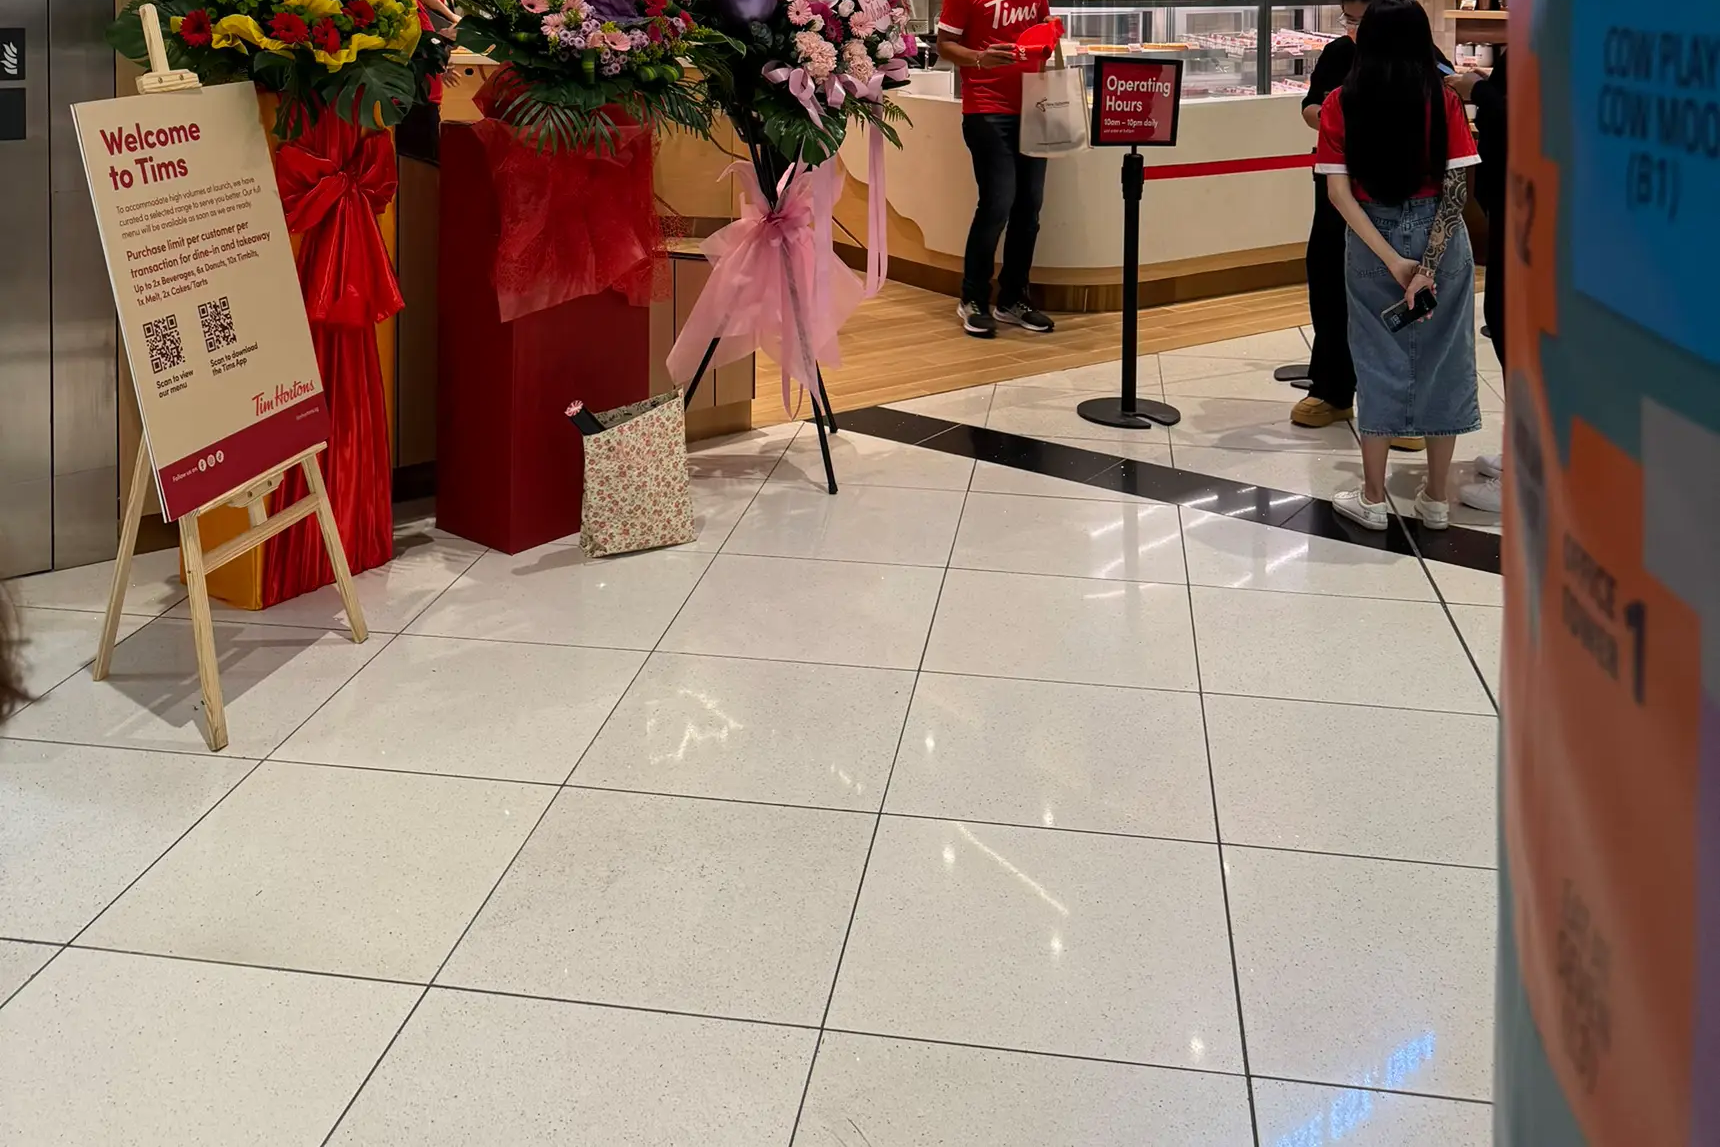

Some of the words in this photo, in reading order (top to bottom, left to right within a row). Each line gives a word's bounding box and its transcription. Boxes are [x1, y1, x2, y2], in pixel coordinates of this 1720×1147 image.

[1604, 26, 1656, 81] COW
[1107, 75, 1171, 97] Operating
[1106, 96, 1142, 112] Hours
[1598, 84, 1649, 140] COW
[100, 122, 200, 155] Welcome
[1104, 118, 1120, 126] 10am
[1127, 119, 1142, 128] 10pm
[1143, 118, 1158, 128] daily
[109, 166, 133, 190] to
[135, 156, 188, 185] Tims
[1627, 152, 1683, 223] (B1)
[116, 205, 124, 214] To
[126, 196, 168, 213] accommodate
[169, 192, 182, 205] high
[183, 187, 206, 200] volumes
[207, 186, 212, 194] at
[233, 180, 241, 188] we
[242, 177, 255, 186] have
[119, 215, 143, 227] curated
[150, 207, 174, 219] selected
[175, 205, 192, 216] range
[193, 200, 198, 209] to
[200, 199, 214, 208] serve
[215, 196, 225, 205] you
[242, 188, 253, 197] Our
[253, 185, 261, 194] full
[122, 230, 140, 240] menu
[141, 225, 151, 235] will
[161, 216, 188, 229] available
[189, 215, 195, 223] as
[196, 211, 210, 221] soon
[211, 210, 217, 218] as
[217, 208, 226, 216] we
[227, 205, 236, 213] are
[126, 243, 166, 261] Purchase
[168, 237, 185, 250] limit
[187, 234, 200, 248] per
[201, 226, 235, 241] customer
[236, 221, 249, 234] per
[130, 256, 179, 278] transaction
[180, 252, 191, 264] for
[192, 244, 220, 261] dine-in
[221, 239, 236, 252] and
[237, 231, 271, 245] takeaway
[134, 284, 144, 294] Up
[145, 281, 152, 290] to
[152, 278, 161, 287] 2x
[161, 268, 196, 285] Beverages,
[196, 266, 205, 275] 6x
[205, 259, 227, 271] Donuts,
[228, 256, 236, 265] 10x
[237, 249, 259, 261] Timbits,
[137, 298, 145, 306] 1x
[145, 292, 162, 303] Melt,
[162, 290, 170, 298] 2x
[171, 278, 208, 295] Cakes/Tarts
[210, 356, 225, 367] Scan
[232, 342, 258, 359] download
[212, 366, 222, 376] the
[222, 362, 236, 371] Tims
[236, 357, 247, 368] App
[156, 378, 172, 389] Scan
[180, 369, 194, 379] view
[159, 389, 169, 398] our
[170, 382, 187, 393] menu
[252, 392, 273, 416] Tim
[274, 379, 315, 408] Hortons
[172, 472, 186, 482] Follow
